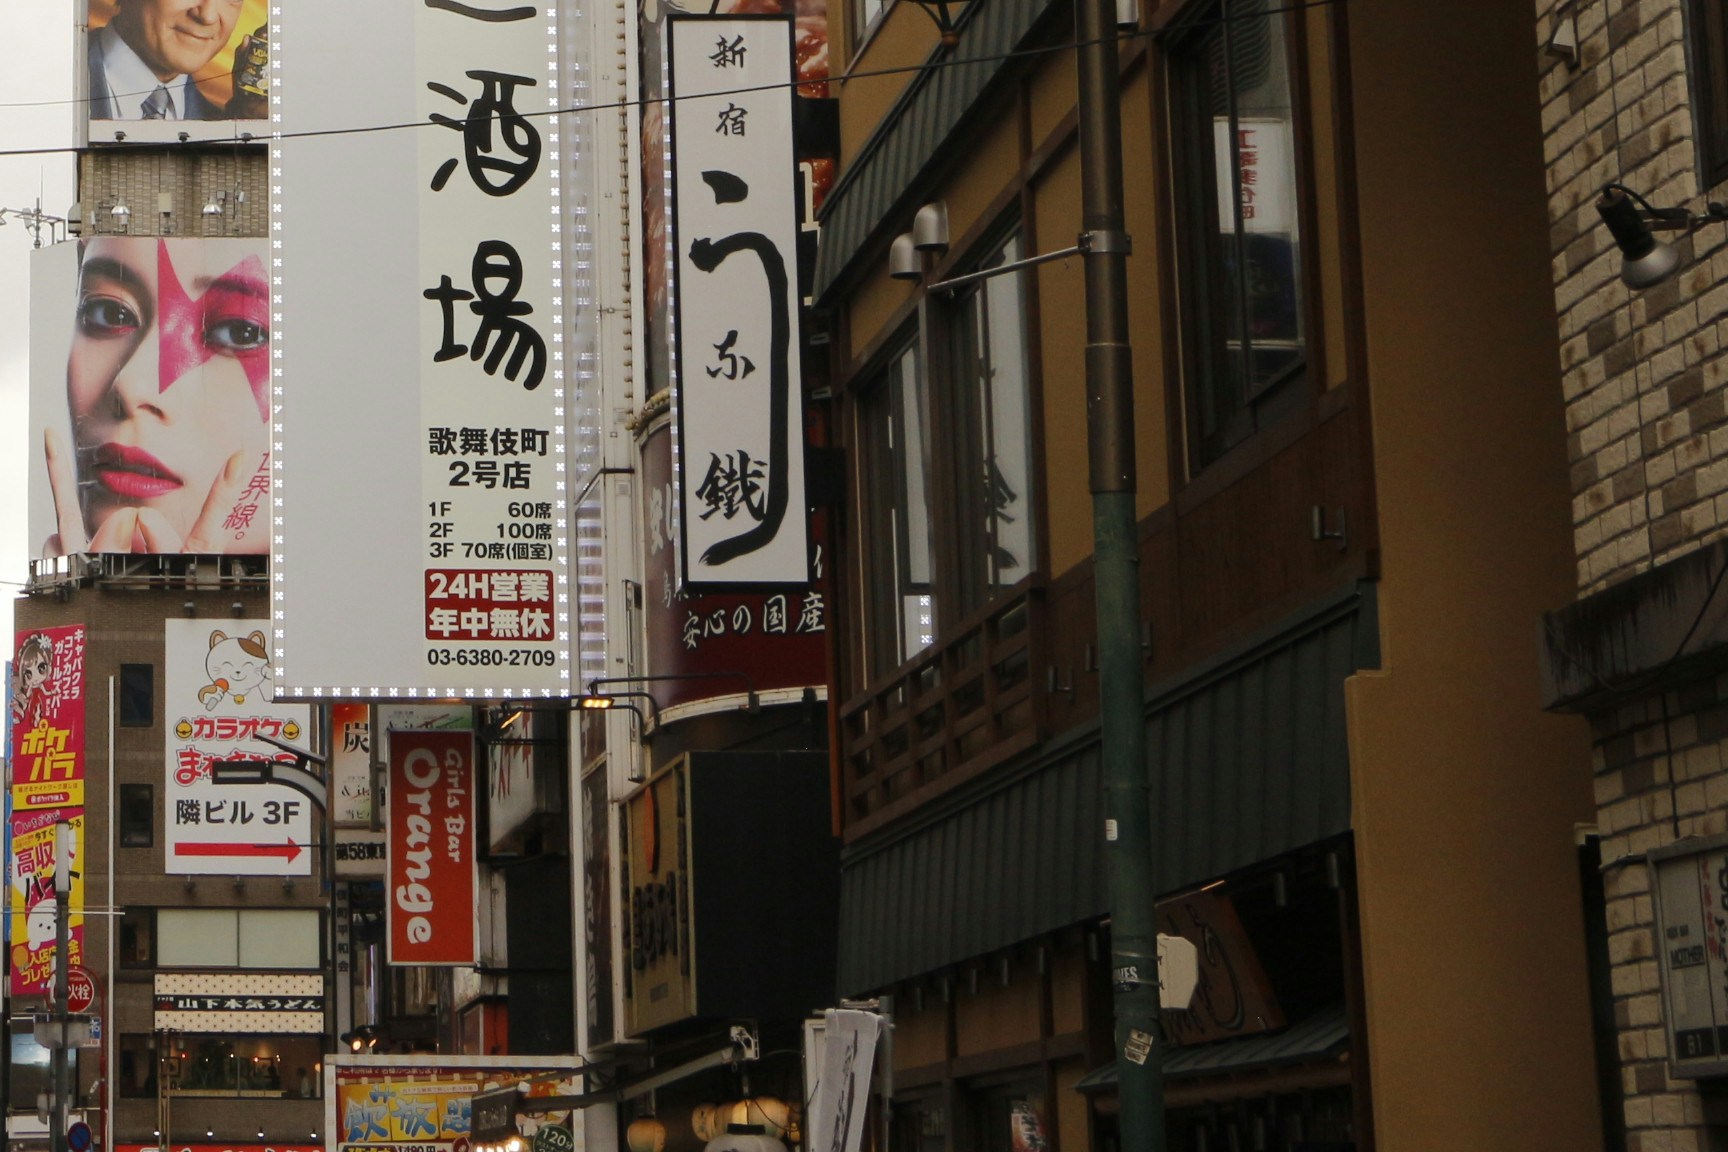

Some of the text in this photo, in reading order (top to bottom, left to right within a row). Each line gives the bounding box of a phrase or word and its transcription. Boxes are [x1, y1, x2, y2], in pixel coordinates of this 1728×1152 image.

[708, 34, 749, 139] 新宿
[428, 427, 550, 457] 歌舞伎町
[448, 461, 532, 489] 2号店
[429, 501, 552, 519] 1F 60席
[429, 522, 553, 539] 2F 100席
[429, 542, 554, 561] 3F 70席(個室)
[429, 572, 550, 602] 24H営業
[429, 607, 550, 638] 年中無休
[683, 592, 826, 651] 安心の国産
[62, 635, 74, 700] コンカフェ
[70, 628, 84, 700] キャバクラ
[427, 648, 555, 666] 03-6380-2709
[51, 641, 65, 719] ガールズバー
[193, 717, 283, 739] カラオケ
[343, 721, 369, 753] 炭
[176, 799, 300, 825] 隣ビル 3F
[443, 749, 466, 863] Girls Bar
[396, 748, 440, 944] Orange
[178, 998, 321, 1010] 山下本気うどん
